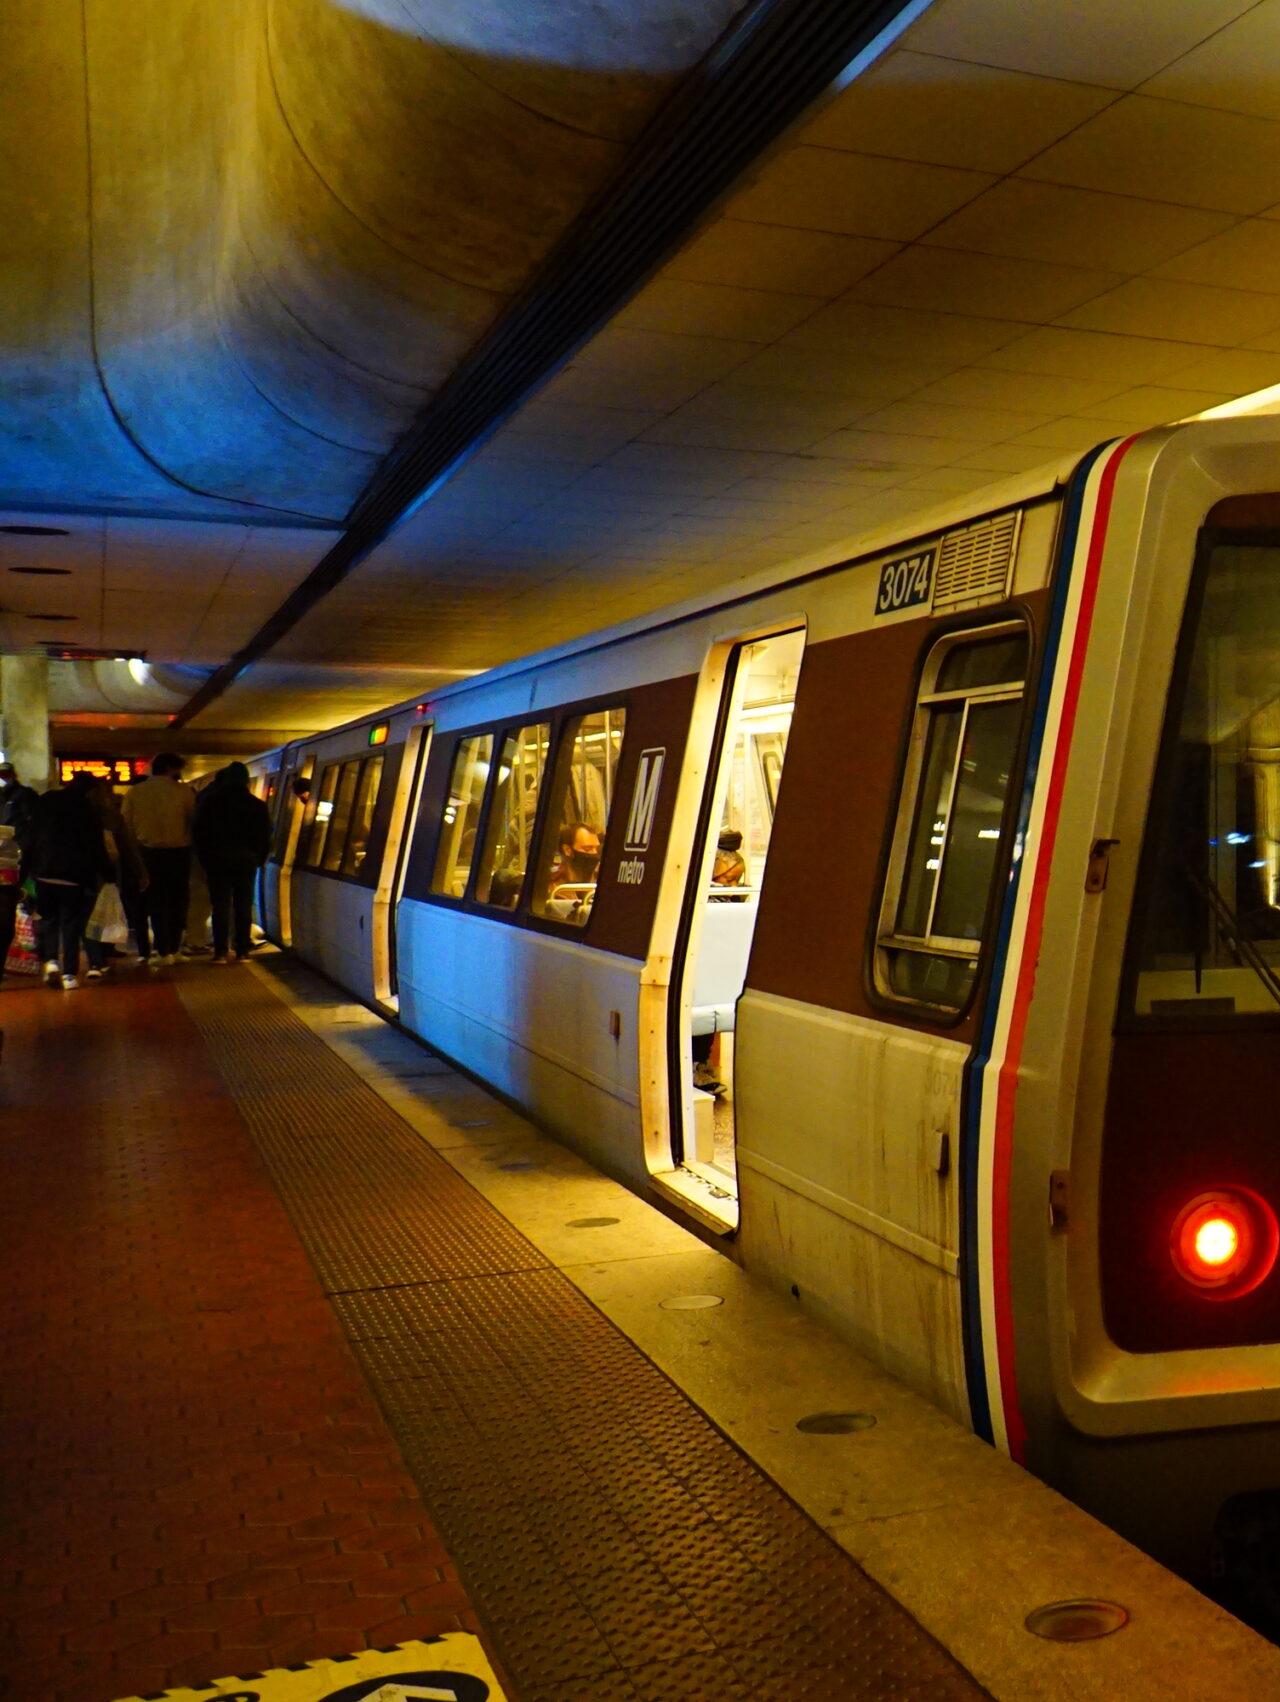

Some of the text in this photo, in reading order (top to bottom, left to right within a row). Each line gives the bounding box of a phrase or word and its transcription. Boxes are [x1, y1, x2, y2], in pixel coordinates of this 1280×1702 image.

[879, 554, 930, 610] 3074
[627, 754, 664, 845] M
[617, 855, 645, 885] metro
